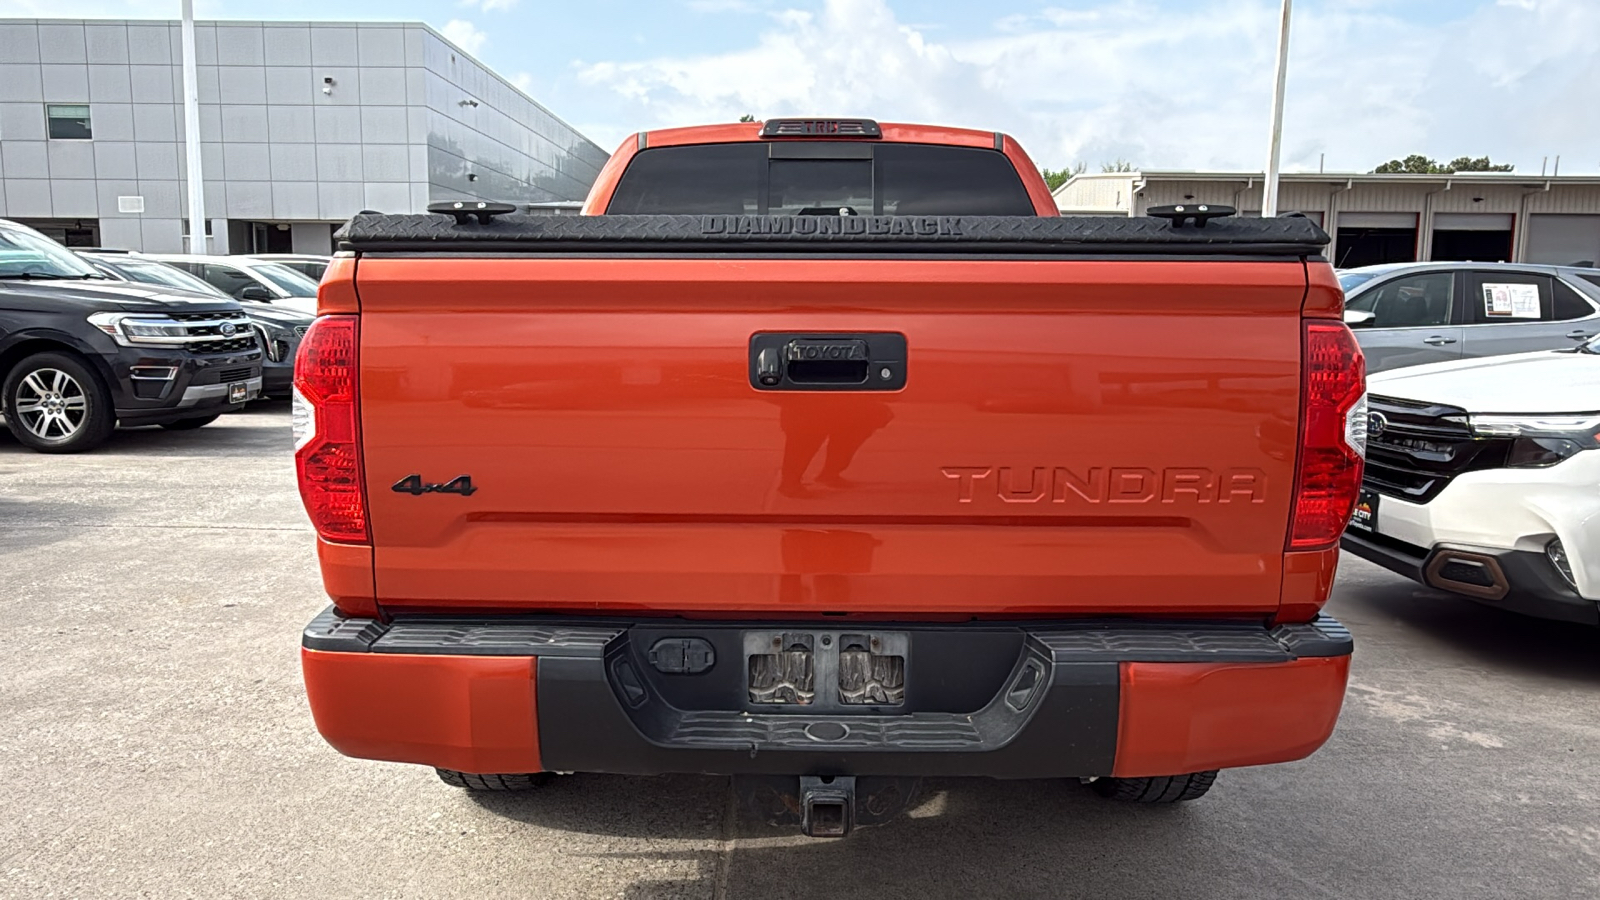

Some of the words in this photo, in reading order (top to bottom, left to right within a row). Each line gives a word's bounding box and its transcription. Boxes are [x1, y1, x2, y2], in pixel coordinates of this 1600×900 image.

[701, 215, 964, 236] DIAMONDBACK
[794, 345, 866, 359] TOYOTA
[940, 466, 1267, 503] TUNDRA
